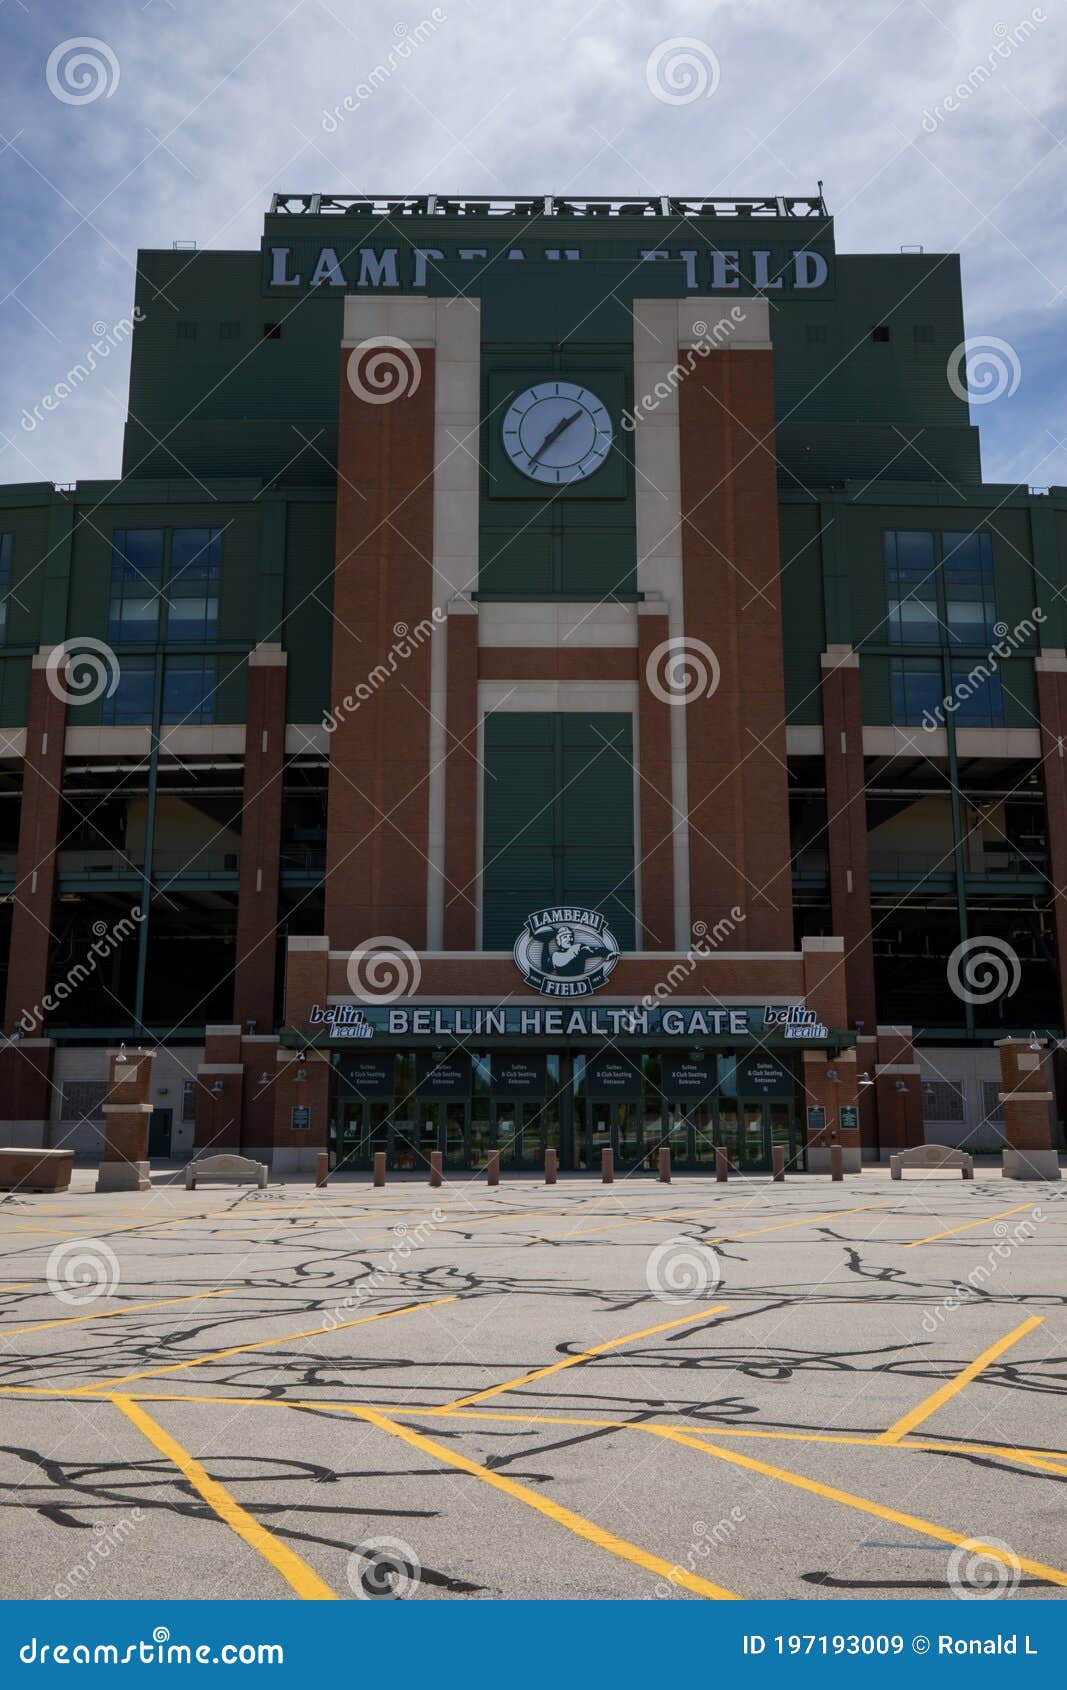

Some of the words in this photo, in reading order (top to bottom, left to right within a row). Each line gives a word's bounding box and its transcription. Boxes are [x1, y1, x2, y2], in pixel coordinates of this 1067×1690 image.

[640, 250, 829, 289] IELD
[531, 908, 600, 929] LAMBEAU
[545, 980, 588, 996] FIELD
[310, 1005, 364, 1023] bellin
[388, 1010, 505, 1035] BELLIN
[520, 1010, 648, 1035] HEALTH
[662, 1010, 749, 1035] GATE
[764, 1005, 816, 1024] bellin
[330, 1022, 374, 1038] health
[784, 1022, 828, 1038] health
